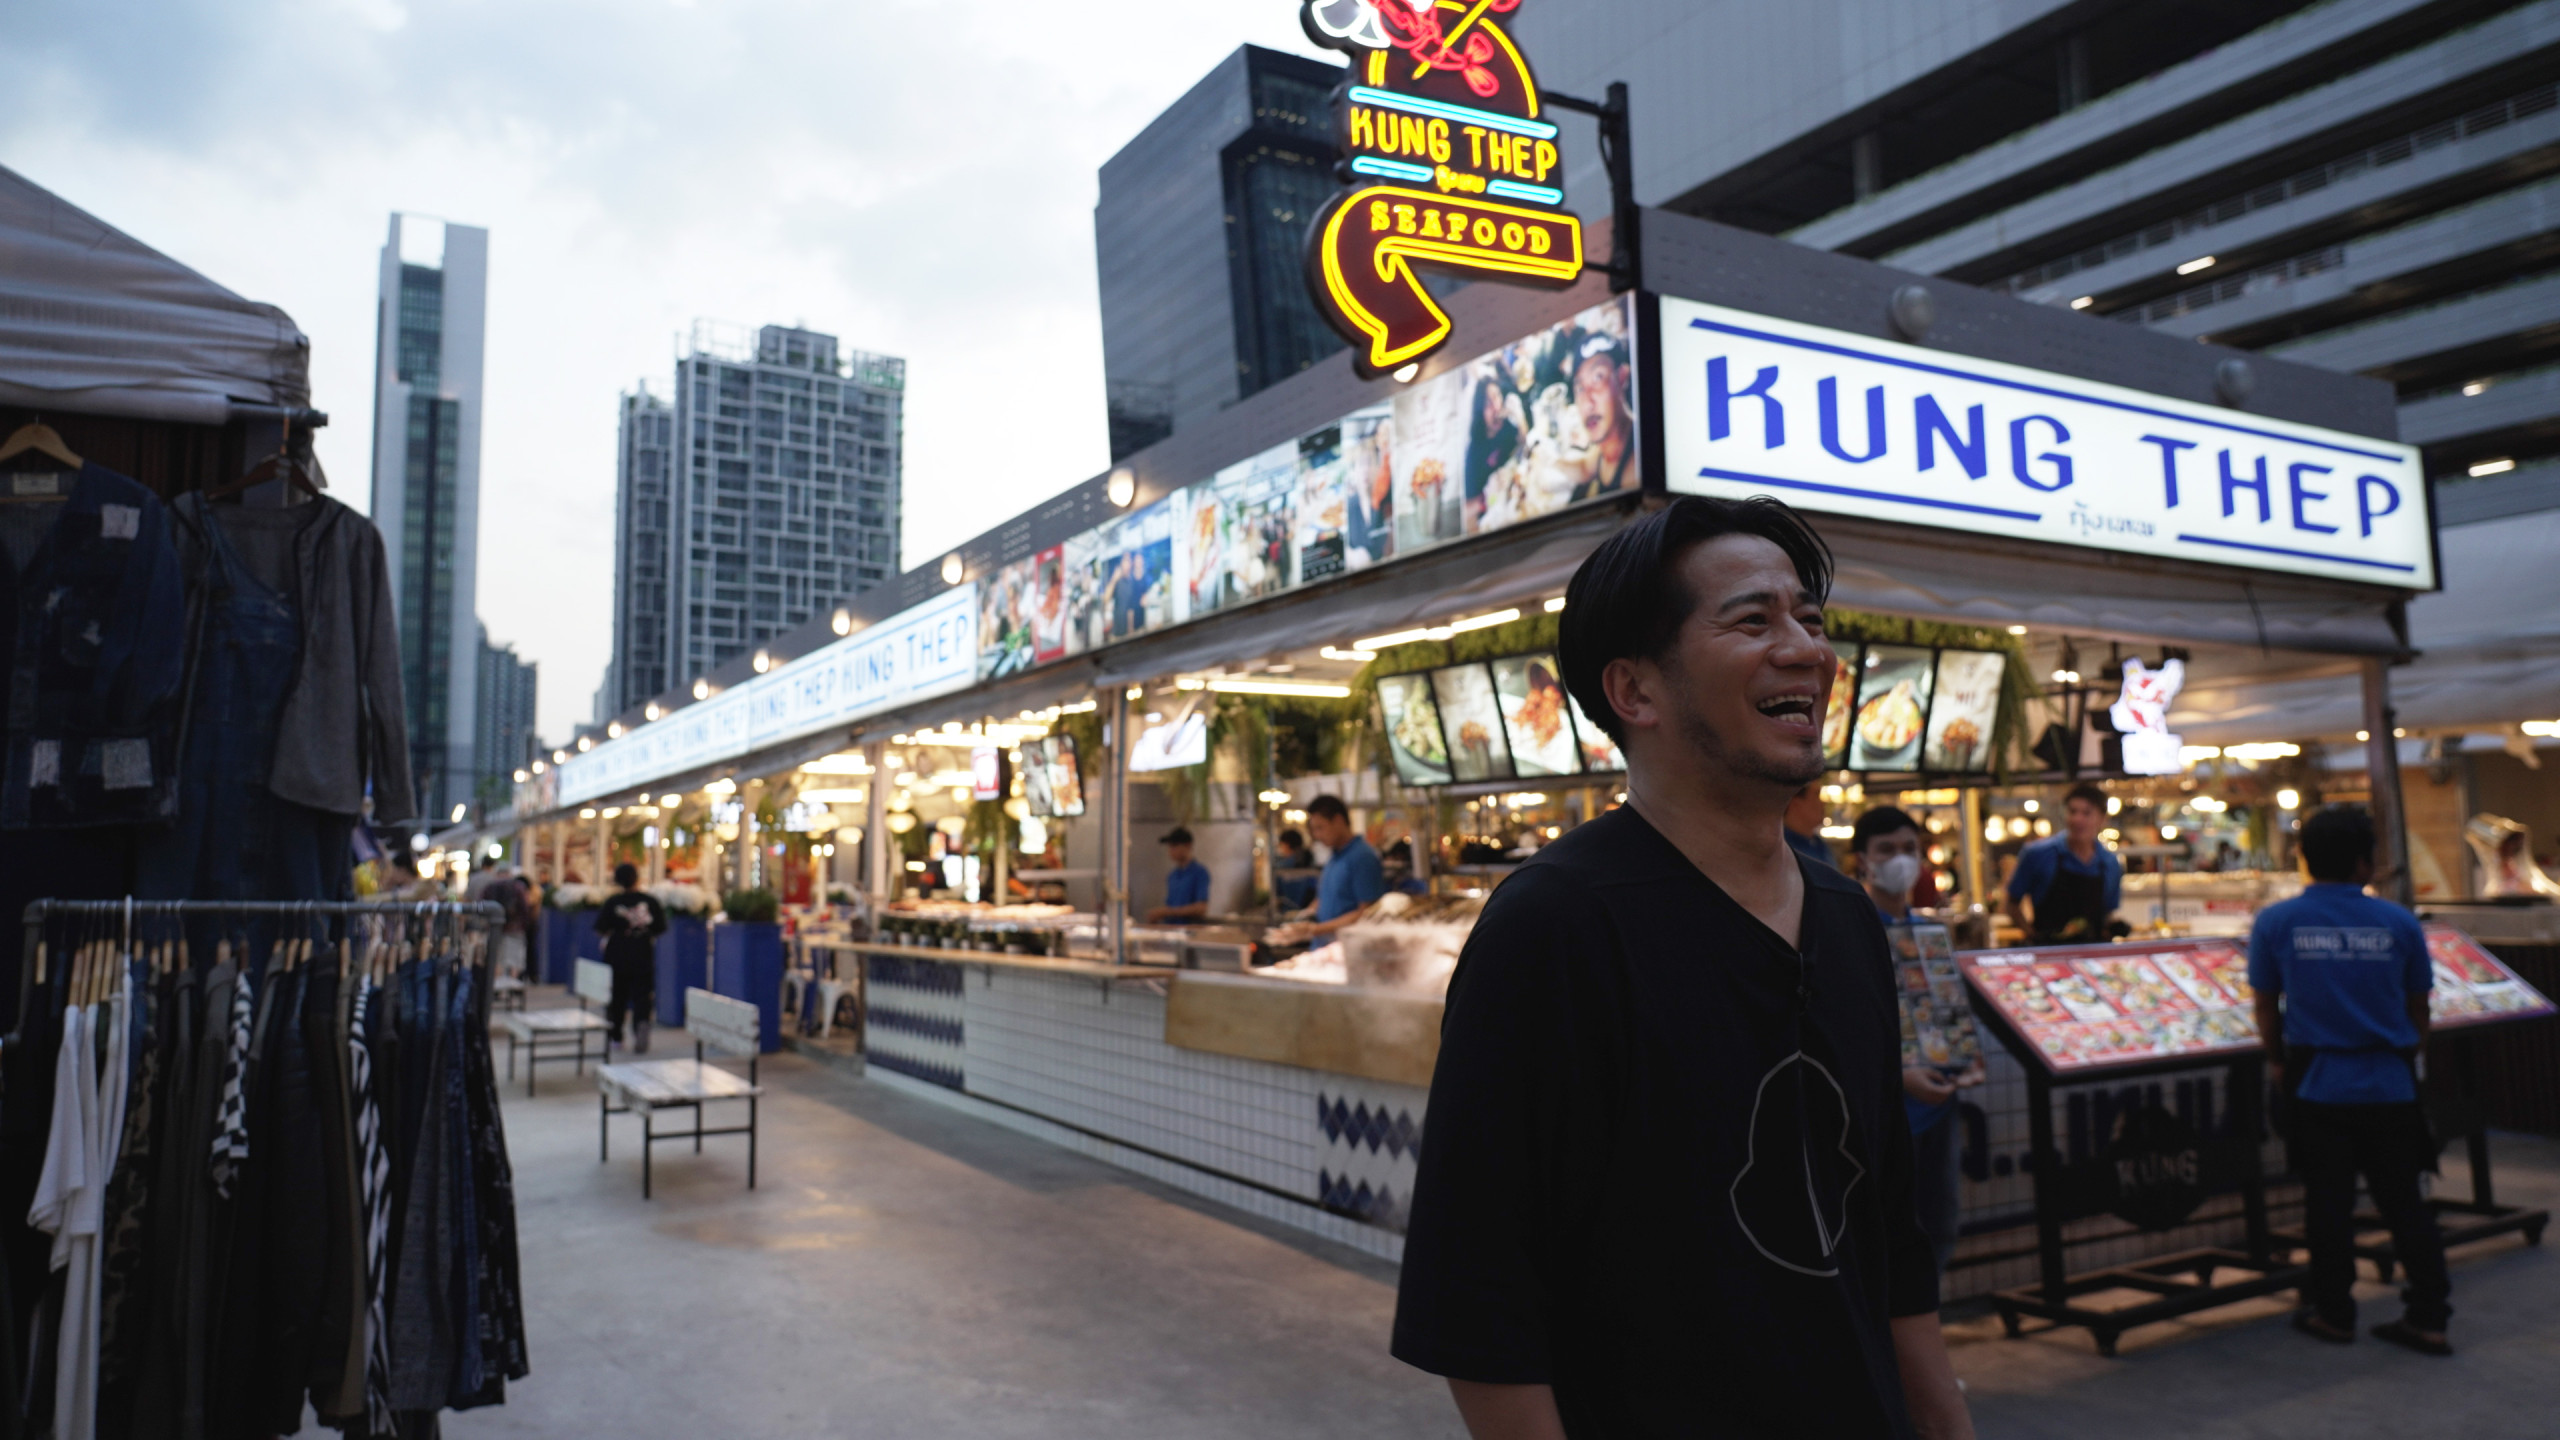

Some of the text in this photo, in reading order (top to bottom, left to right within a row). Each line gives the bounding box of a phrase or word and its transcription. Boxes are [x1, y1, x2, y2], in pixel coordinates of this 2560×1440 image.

[1351, 106, 1451, 163] KUNG
[1463, 126, 1557, 181] THEP
[1370, 201, 1551, 254] SEAFOOD
[1706, 356, 2401, 539] KUNG THEP
[907, 614, 968, 671] THEP
[794, 667, 835, 709] THEP
